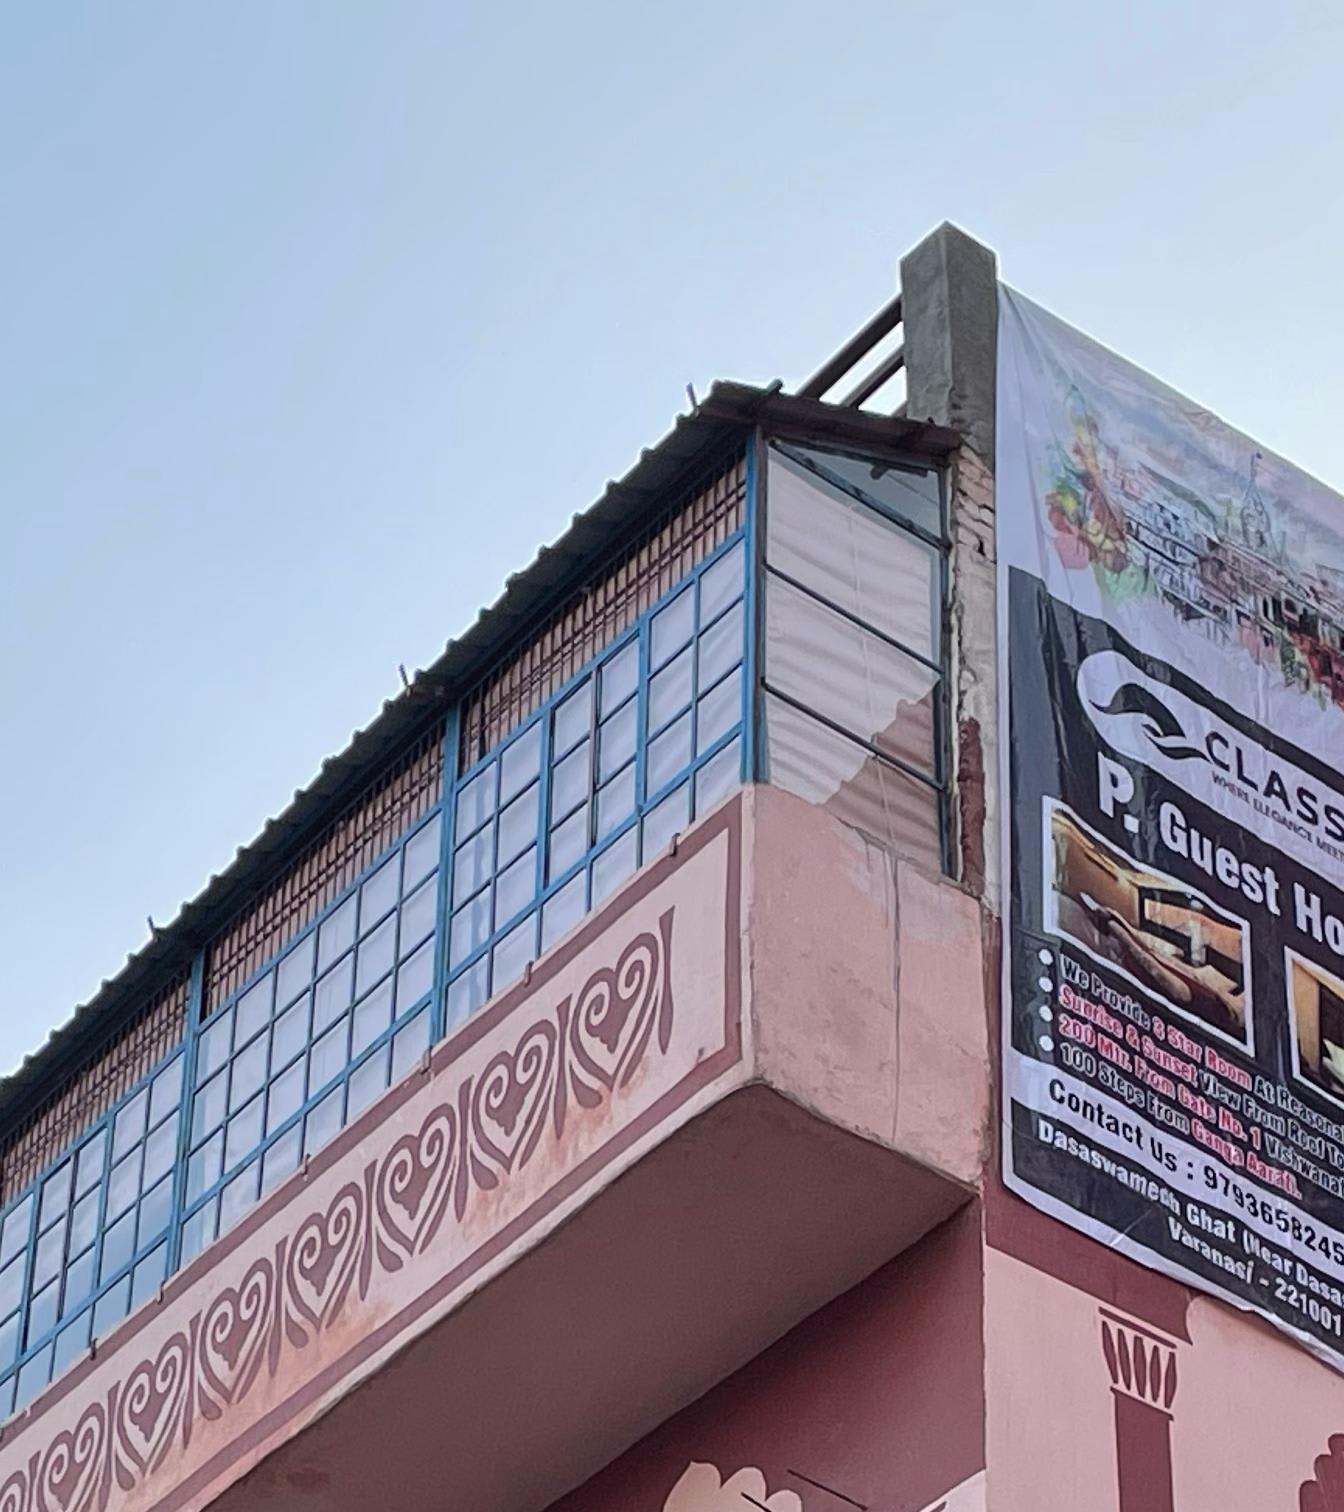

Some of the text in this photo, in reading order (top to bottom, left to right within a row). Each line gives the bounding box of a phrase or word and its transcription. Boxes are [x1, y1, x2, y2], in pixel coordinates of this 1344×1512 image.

[1096, 751, 1140, 834] P.
[1159, 801, 1283, 917] Guest
[1059, 983, 1123, 1039] Sunrise
[1125, 1023, 1141, 1052] &
[1141, 1035, 1199, 1088] Sunset
[1199, 1069, 1242, 1111] View
[1243, 1093, 1286, 1138] From
[1288, 1118, 1326, 1160] Roof
[1059, 1013, 1096, 1049] 200
[1134, 1054, 1176, 1101] From
[1177, 1083, 1217, 1124] Gate
[1218, 1105, 1249, 1142] No.
[1249, 1126, 1261, 1150] 1
[1060, 953, 1089, 990] We
[1091, 972, 1152, 1031] Provide
[1167, 1024, 1203, 1063] Star
[1205, 1046, 1253, 1091] Room
[1255, 1074, 1275, 1104] At
[1049, 1078, 1144, 1151] Contact
[1150, 1136, 1178, 1173] Us
[1060, 1042, 1097, 1078] 100
[1098, 1061, 1146, 1108] Steps
[1191, 1118, 1245, 1167] Ganga
[1168, 1216, 1254, 1285] Varanasi
[1274, 1276, 1343, 1337] 221001
[1186, 1202, 1237, 1244] Ghat
[1242, 1228, 1293, 1278] (Near
